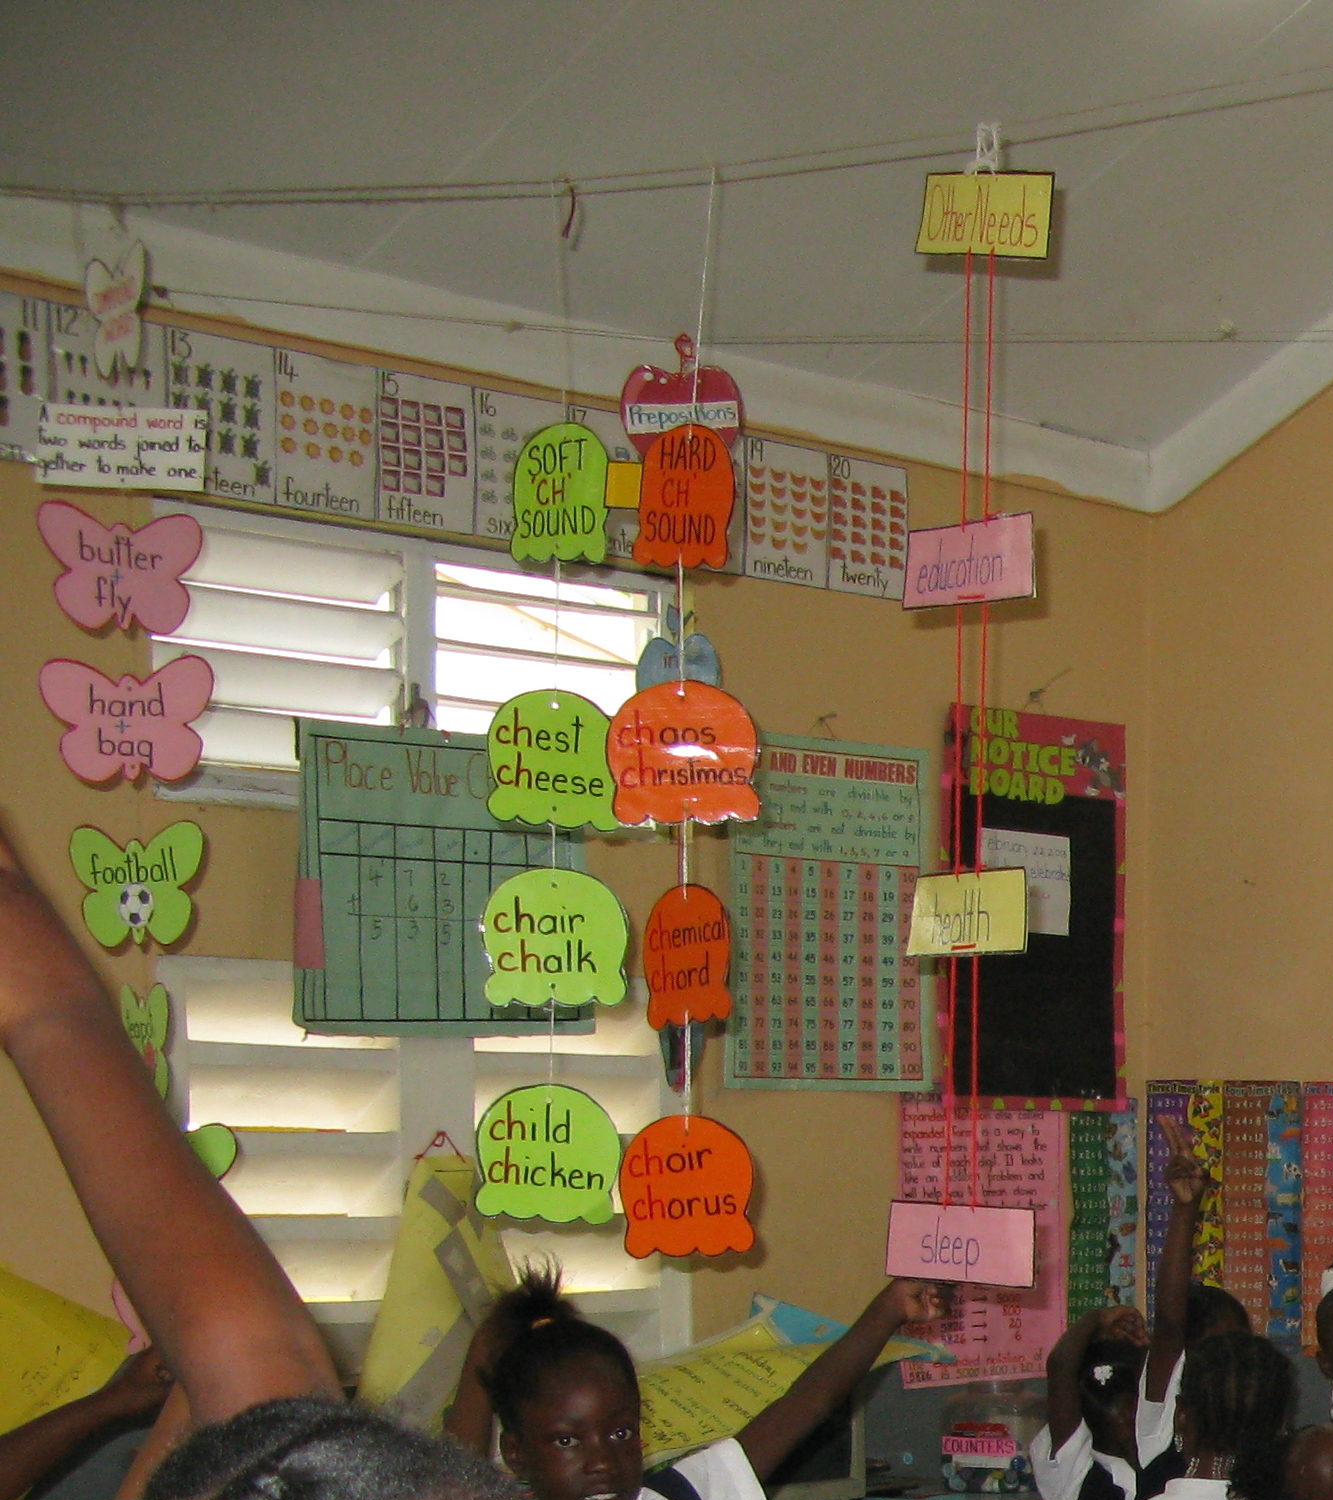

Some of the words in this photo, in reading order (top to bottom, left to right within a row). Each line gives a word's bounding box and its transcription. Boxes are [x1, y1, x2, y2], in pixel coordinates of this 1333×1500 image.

[927, 184, 972, 242] Other
[971, 184, 1038, 247] Needs
[57, 412, 138, 433] compound
[147, 410, 183, 429] word
[629, 407, 736, 430] Prepositions
[37, 453, 86, 477] gether
[97, 456, 111, 473] to
[116, 458, 156, 477] make
[78, 434, 127, 451] words
[137, 436, 180, 460] joined
[527, 437, 587, 477] SOFT
[660, 437, 716, 472] HARD
[282, 477, 359, 513] fourteen
[387, 496, 443, 527] fifteen
[520, 506, 596, 539] SOUND
[646, 512, 716, 545] SOUND
[79, 530, 163, 570] butter
[754, 555, 813, 582] nineteen
[917, 535, 1004, 594] education
[95, 576, 132, 621] fly
[841, 561, 889, 599] twenty
[89, 682, 165, 717] hand
[496, 707, 583, 754] chest
[618, 709, 716, 745] chaos
[970, 707, 1019, 739] OUR
[98, 727, 153, 768] bag
[970, 734, 1077, 776] NOTICE
[324, 740, 394, 791] Place
[406, 749, 459, 798] Value
[497, 751, 604, 797] cheese
[620, 750, 749, 789] christmas
[770, 751, 797, 774] AND
[802, 753, 837, 777] EVEN
[844, 758, 916, 785] NUMBERS
[970, 766, 1064, 805] BOARD
[90, 846, 177, 884] football
[493, 896, 585, 934] chair
[650, 906, 726, 951] chemical
[932, 888, 990, 944] health
[498, 939, 597, 974] chalk
[651, 952, 709, 993] chord
[489, 1100, 570, 1144] child
[488, 1146, 604, 1190] chicken
[628, 1138, 712, 1178] choir
[633, 1185, 737, 1221] chorus
[921, 1216, 980, 1279] sleep
